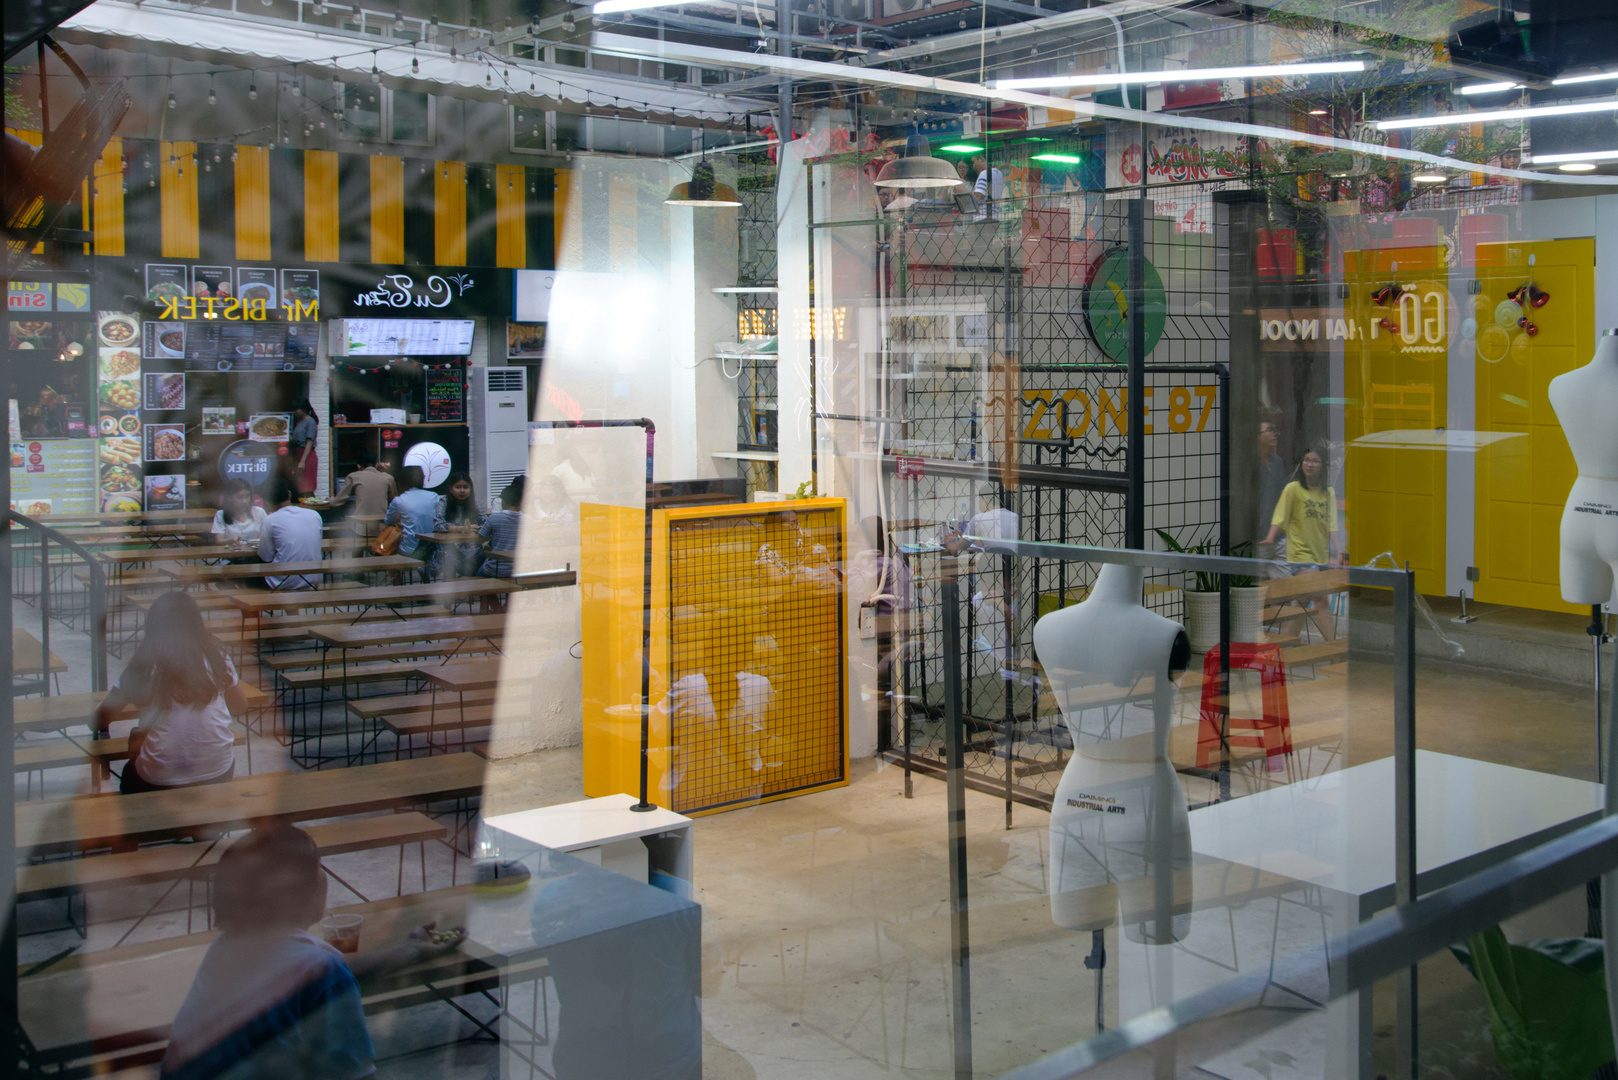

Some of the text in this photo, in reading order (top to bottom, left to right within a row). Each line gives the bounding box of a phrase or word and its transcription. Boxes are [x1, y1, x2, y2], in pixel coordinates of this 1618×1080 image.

[1104, 329, 1150, 342] workp
[1022, 386, 1217, 439] ZONE 87
[1574, 506, 1603, 515] INDUSTRIAL
[1079, 793, 1116, 803] DAIMING
[1066, 798, 1126, 815] INDUSTRIAL ARTS
